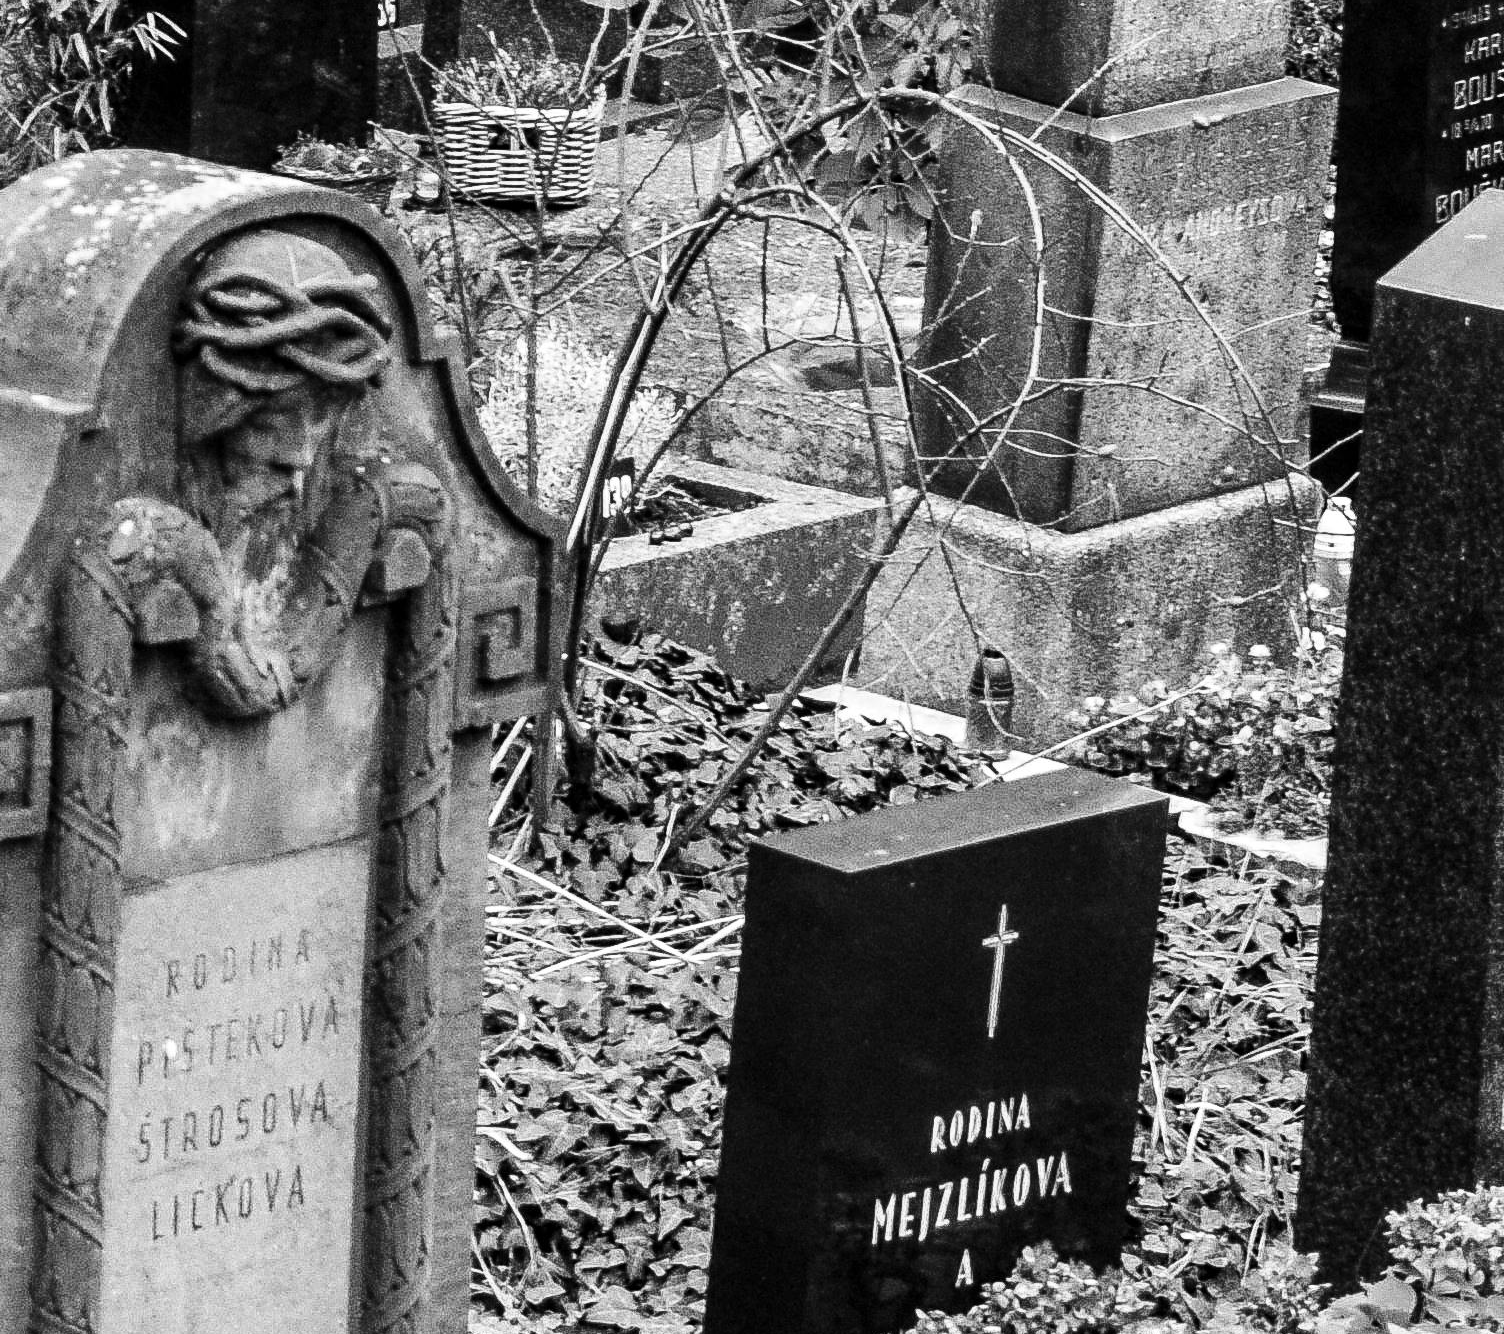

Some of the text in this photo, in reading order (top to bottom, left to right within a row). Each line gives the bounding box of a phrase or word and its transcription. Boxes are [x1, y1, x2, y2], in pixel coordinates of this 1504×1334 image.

[165, 928, 310, 998] RODINA
[930, 1092, 1032, 1154] RODINA
[871, 1150, 1073, 1246] MEJZLÍKOVA
[954, 1248, 974, 1288] A
